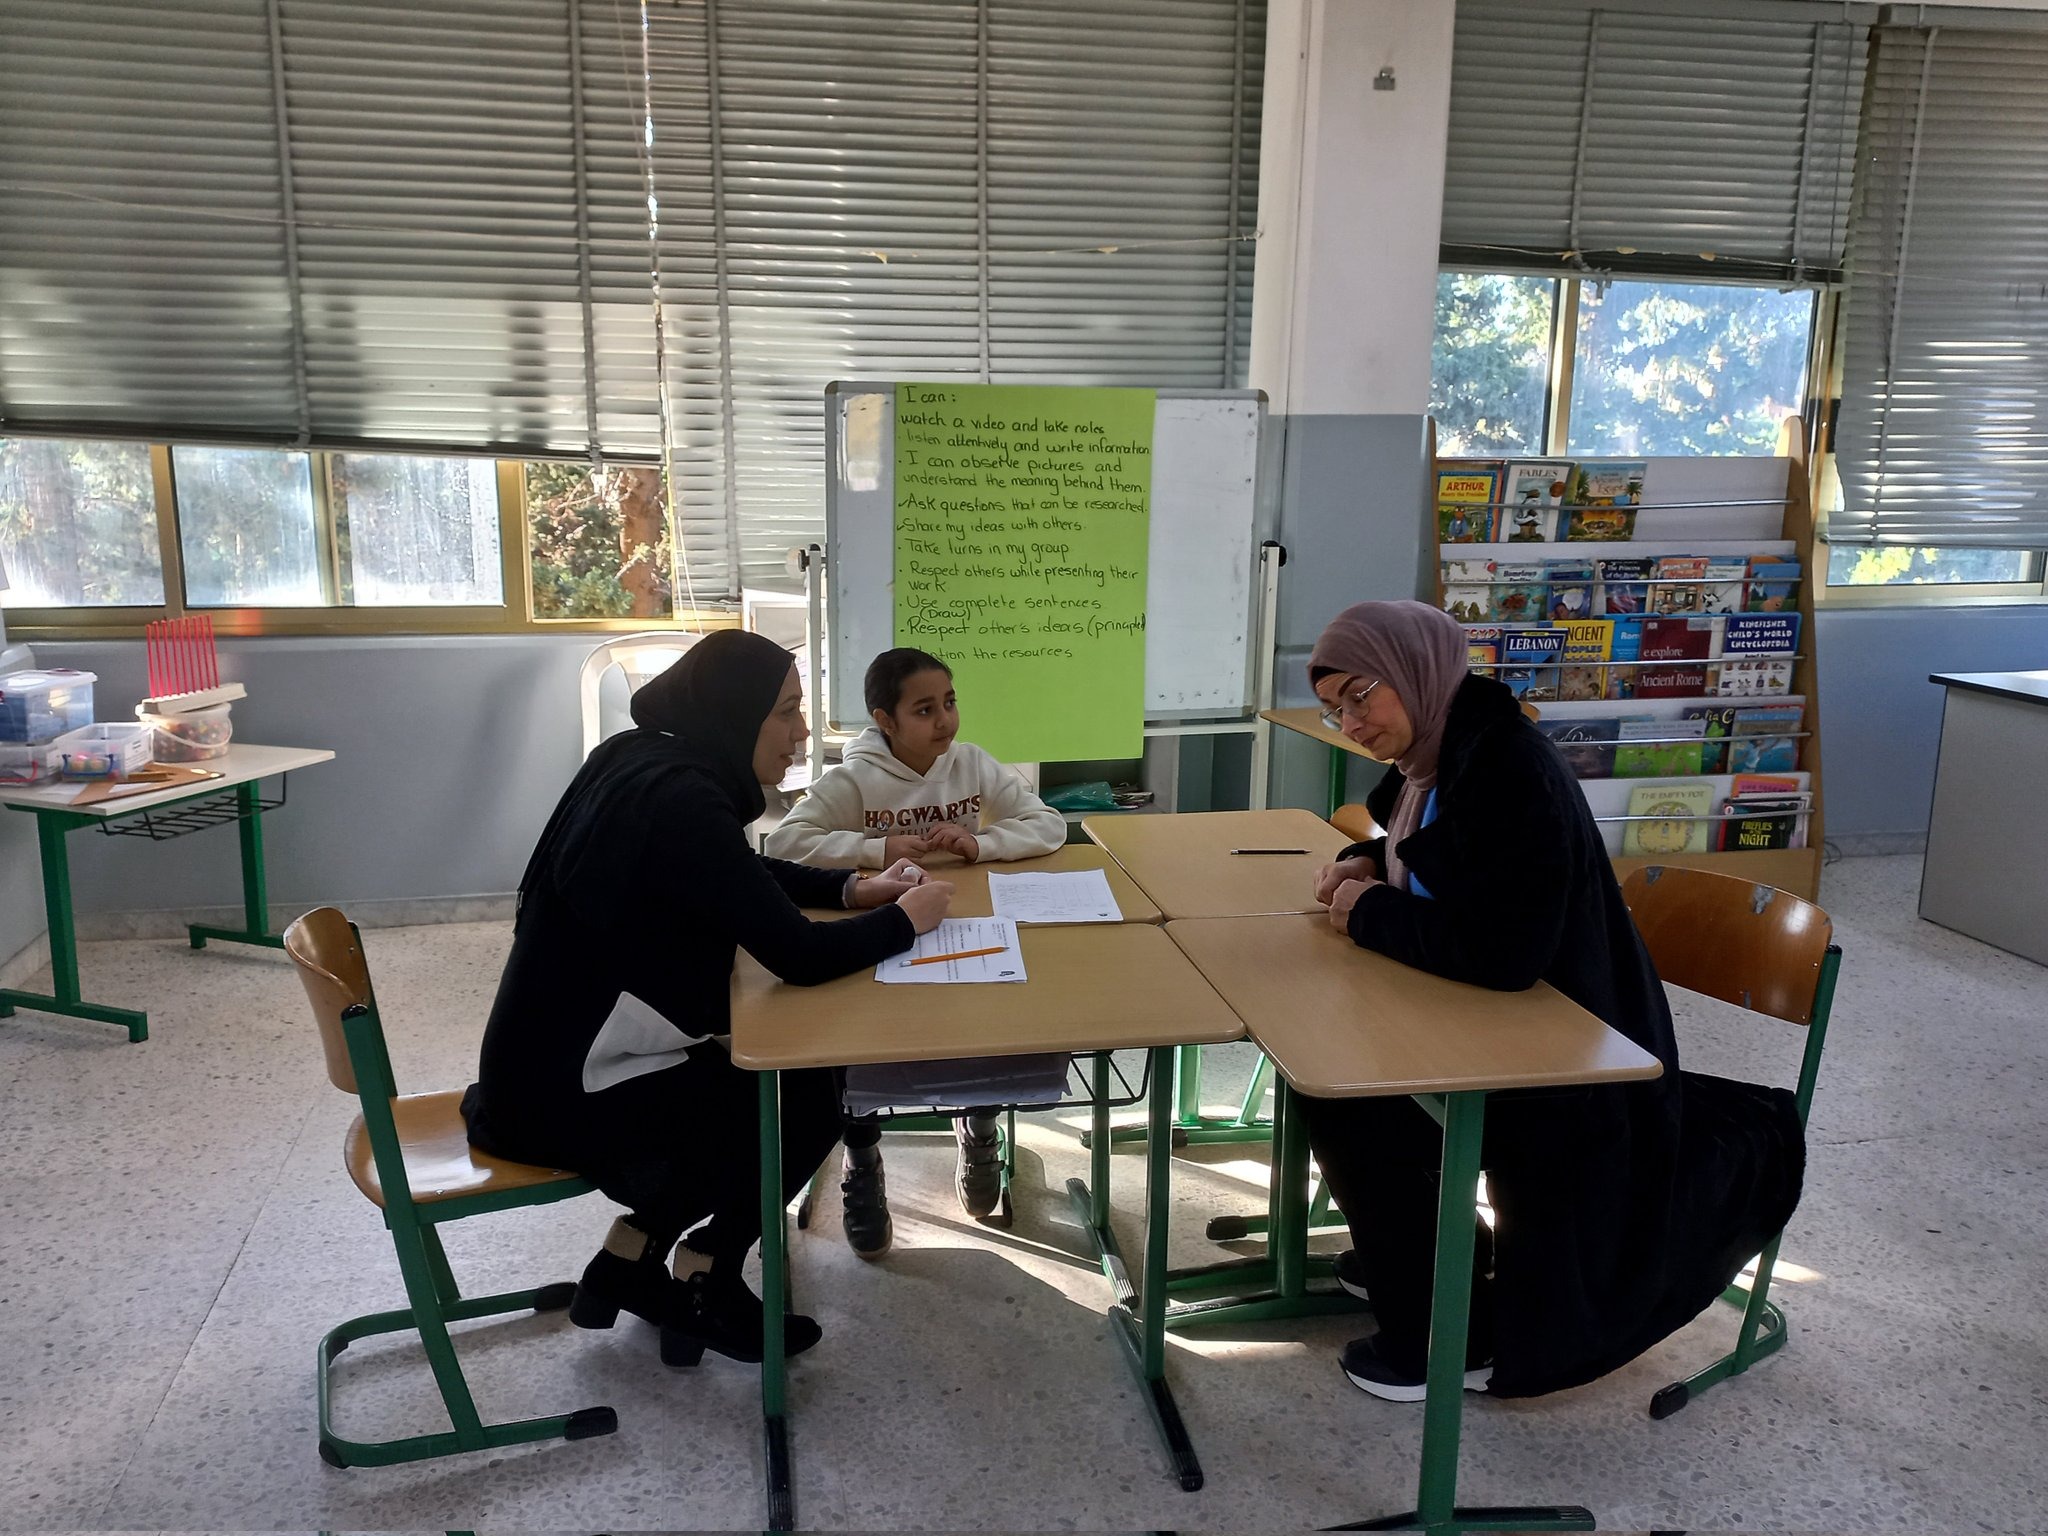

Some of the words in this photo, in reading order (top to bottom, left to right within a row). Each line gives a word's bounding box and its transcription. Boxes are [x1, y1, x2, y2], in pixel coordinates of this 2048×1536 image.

[904, 386, 917, 403] I
[901, 411, 947, 426] watch
[953, 417, 965, 428] a
[971, 413, 1006, 430] video
[1012, 417, 1038, 432] and
[1044, 420, 1069, 433] take
[947, 433, 1009, 459] attentively
[1014, 437, 1039, 452] and
[1046, 439, 1084, 453] write
[1089, 437, 1150, 454] information
[906, 450, 918, 465] I
[927, 457, 954, 468] can
[961, 454, 1020, 469] observe
[1028, 458, 1084, 475] pictures
[1095, 457, 1122, 472] and
[1519, 469, 1558, 477] FABLES
[903, 470, 977, 487] understand
[986, 473, 1006, 488] the
[1012, 477, 1060, 496] meaning
[1063, 473, 1104, 490] behind
[1446, 482, 1485, 491] ARTHUR
[907, 493, 936, 510] Ask
[940, 497, 1005, 518] questions
[1012, 498, 1035, 510] that
[1040, 501, 1059, 509] can
[1063, 496, 1079, 509] be
[902, 517, 942, 531] Share
[946, 523, 965, 540] my
[971, 517, 1005, 532] ideas
[1011, 516, 1038, 530] with
[904, 538, 940, 555] Take
[948, 538, 983, 554] turns
[989, 542, 1001, 554] in
[1006, 544, 1027, 564] my
[1031, 542, 1069, 563] group
[910, 560, 959, 581] Respect
[965, 563, 1005, 577] others
[1010, 561, 1041, 577] while
[1044, 562, 1105, 587] presenting
[1110, 564, 1139, 579] their
[907, 595, 938, 609] Use
[949, 595, 1016, 616] complete
[1025, 594, 1101, 609] sentences
[907, 615, 970, 641] Respect
[978, 620, 1030, 635] other's
[1038, 616, 1084, 633] ideas
[1739, 620, 1787, 628] KINGFISHER
[1566, 626, 1606, 641] NCIENT
[1728, 630, 1760, 639] CHILD'S
[1764, 630, 1792, 638] WORLD
[1509, 637, 1560, 651] LEBANON
[1564, 645, 1603, 653] EOPLES
[1731, 640, 1790, 648] ENCYCLOPEDIA
[919, 645, 966, 660] ntion
[973, 646, 997, 660] the
[1002, 647, 1072, 659] resources
[1640, 674, 1674, 687] Ancient
[1676, 674, 1703, 687] Rome
[1641, 792, 1657, 800] THE
[1659, 791, 1687, 799] EMPTY
[1688, 791, 1705, 799] POT
[864, 793, 980, 829] HOGWARTS
[1741, 821, 1773, 831] FIREFLIES
[1739, 834, 1771, 846] NIGHT
